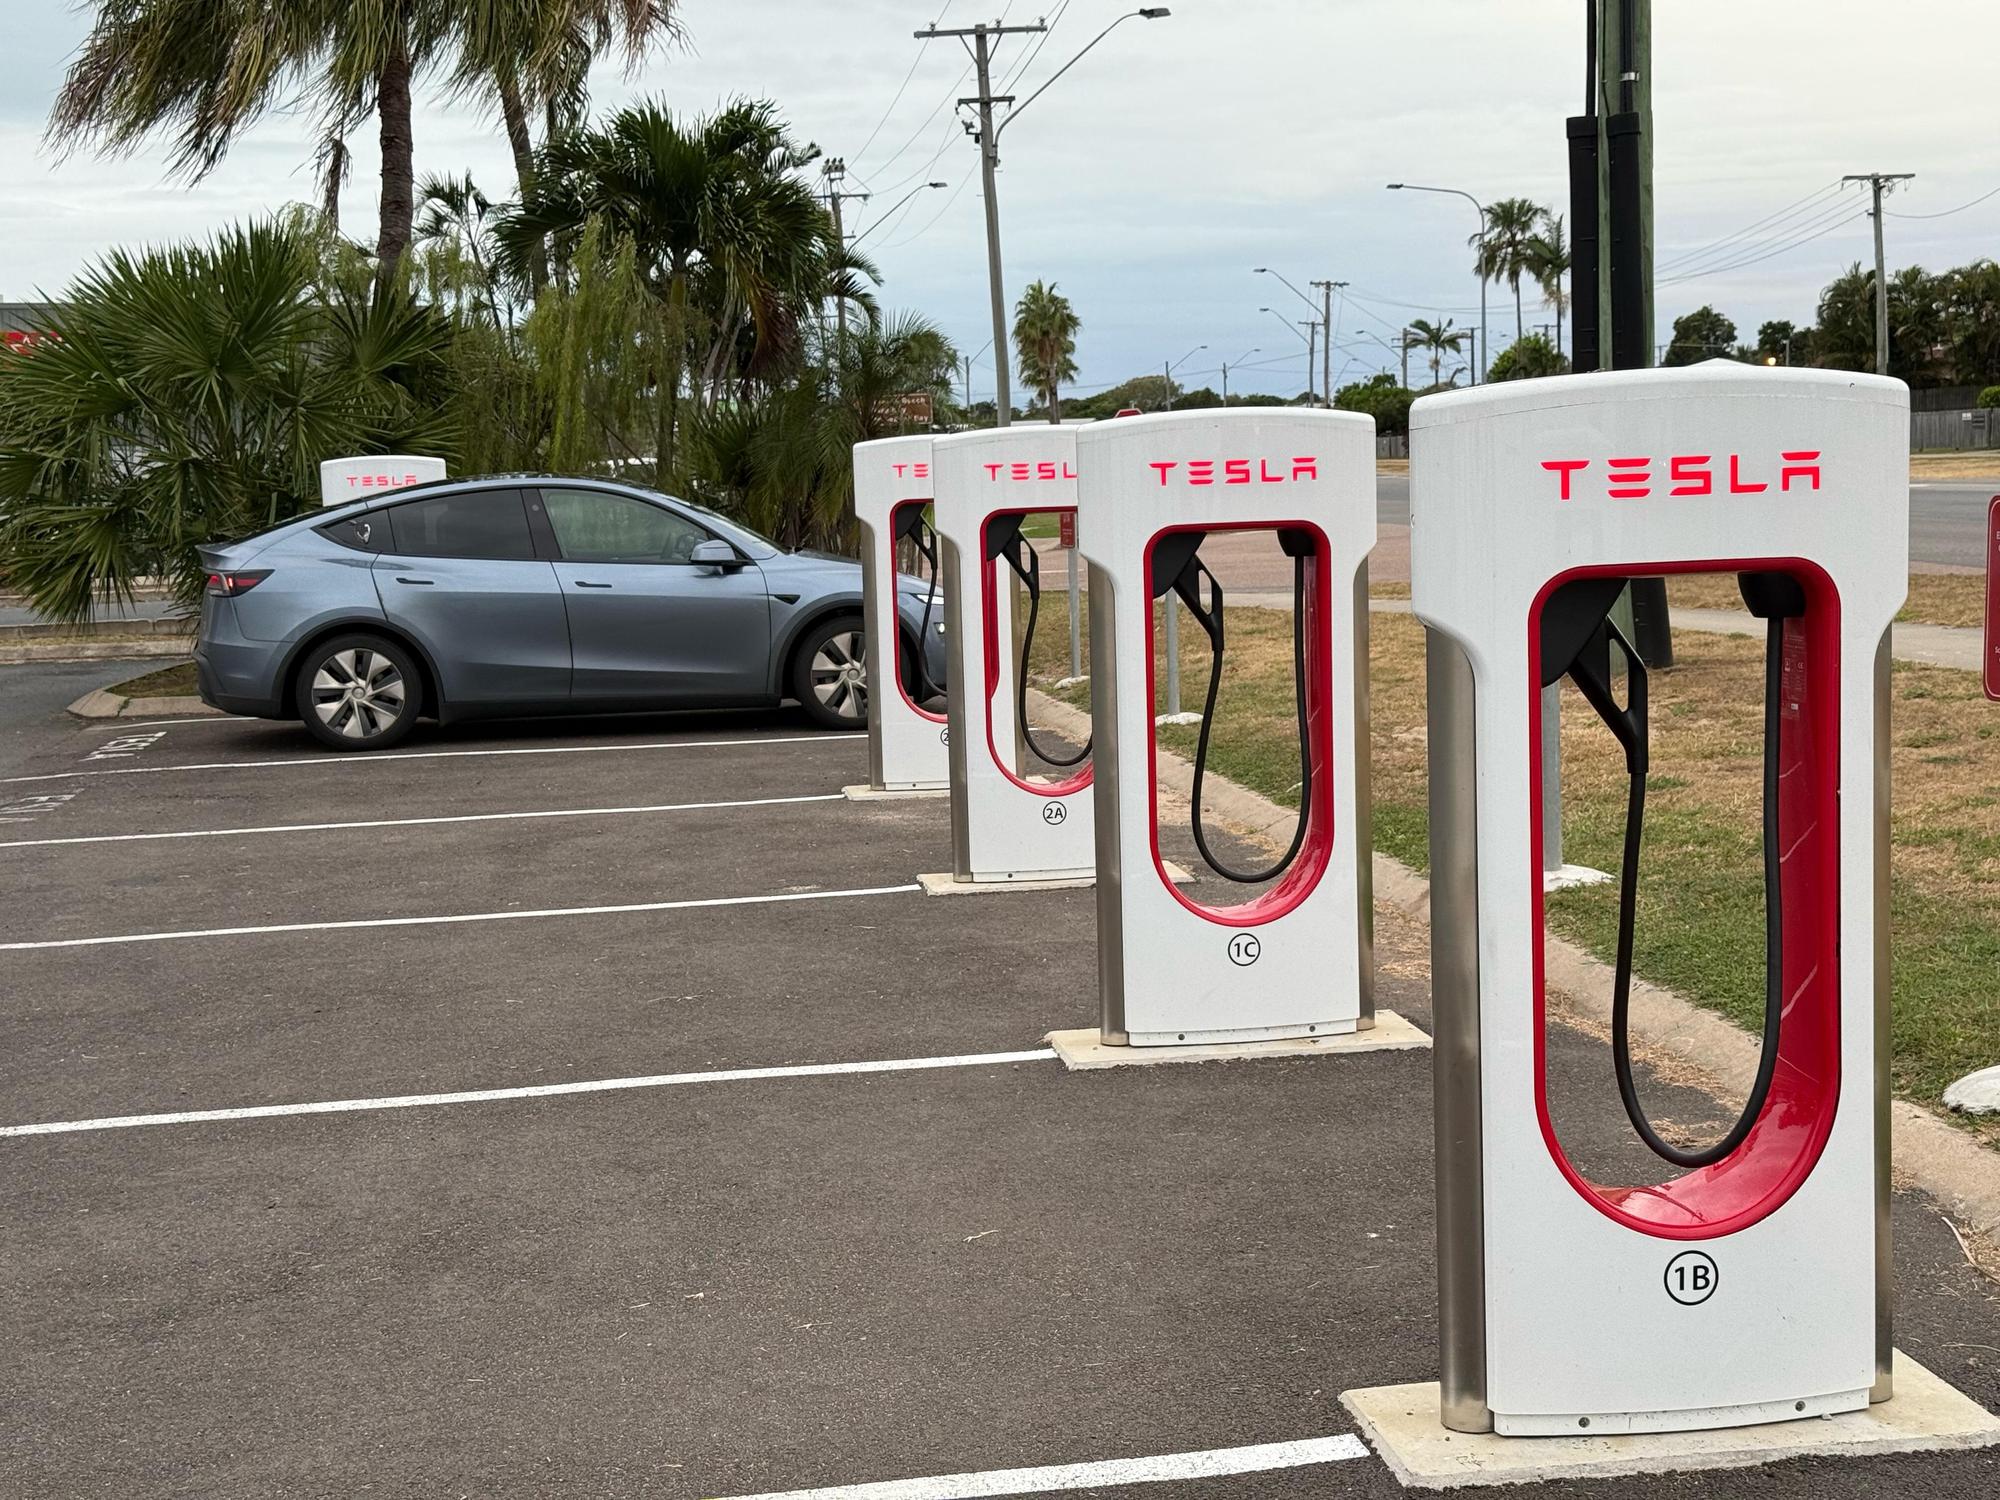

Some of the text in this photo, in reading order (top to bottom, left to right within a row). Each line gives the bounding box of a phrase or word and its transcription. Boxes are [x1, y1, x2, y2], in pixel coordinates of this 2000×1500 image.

[346, 474, 417, 487] TESLA
[983, 462, 1078, 482] TESL
[1149, 457, 1317, 487] TESLA
[1541, 451, 1821, 500] TESLA
[1046, 807, 1063, 819] 2A
[1234, 941, 1256, 958] 1C
[1674, 1264, 1710, 1291] 1B
